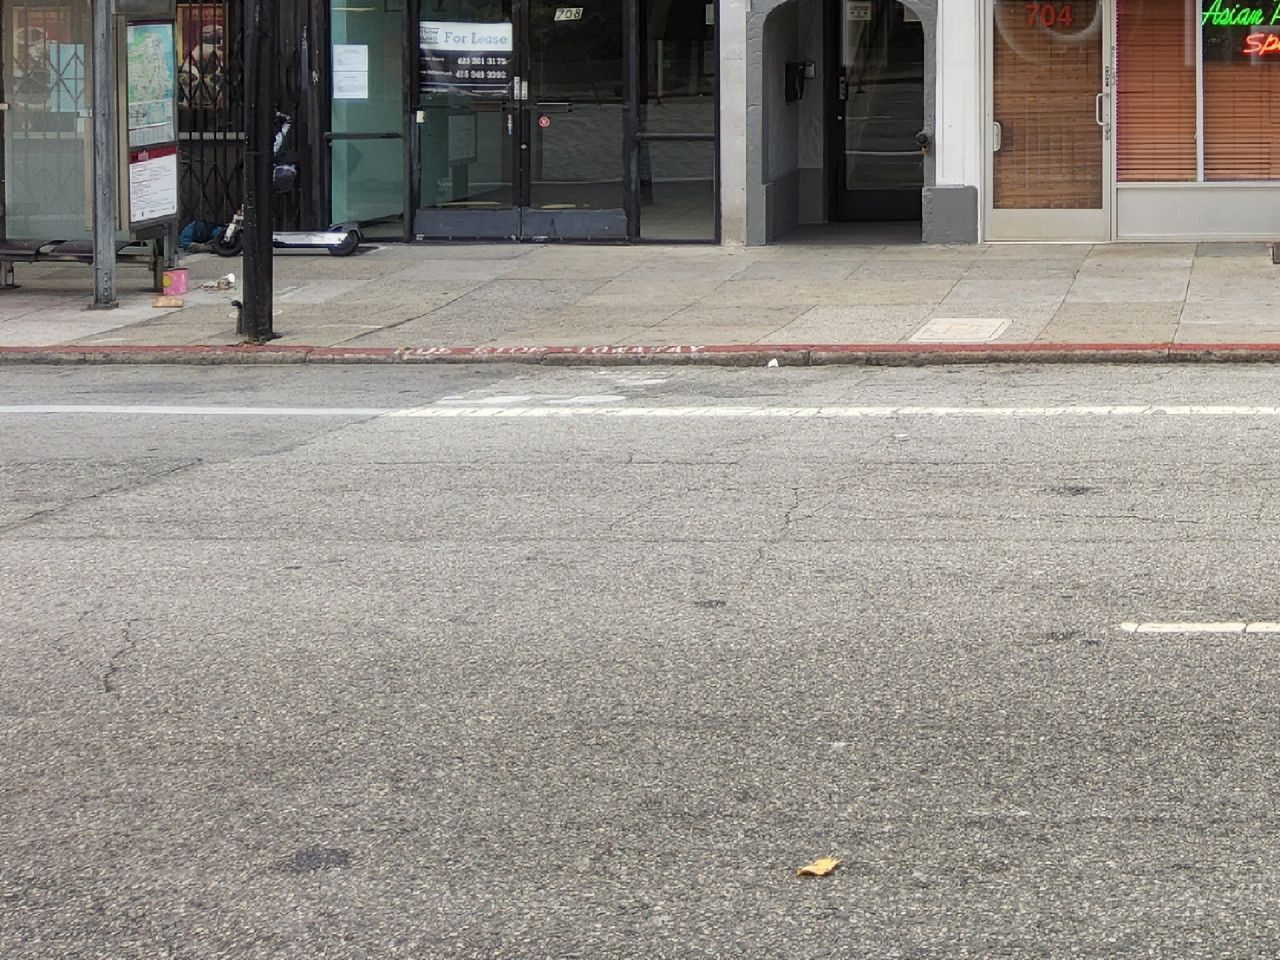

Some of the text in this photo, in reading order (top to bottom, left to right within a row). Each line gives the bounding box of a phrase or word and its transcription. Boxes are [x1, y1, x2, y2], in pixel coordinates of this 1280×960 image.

[1024, 3, 1073, 30] 704
[445, 31, 467, 43] For
[471, 32, 508, 45] Lease
